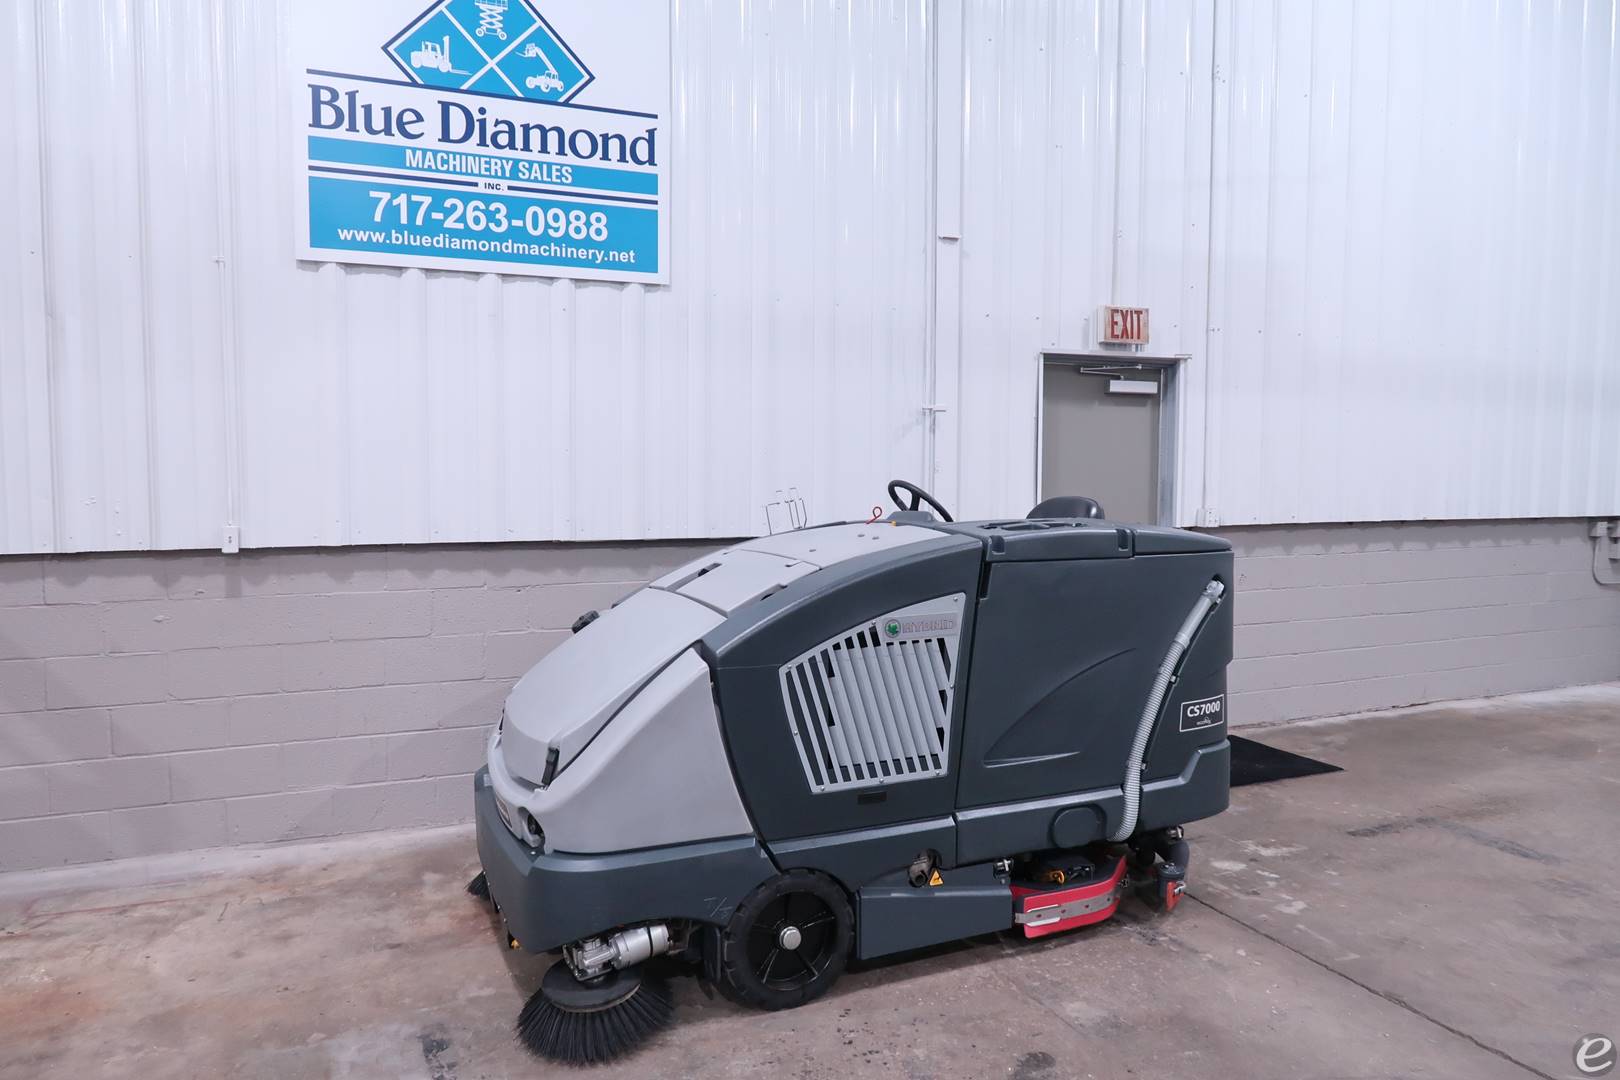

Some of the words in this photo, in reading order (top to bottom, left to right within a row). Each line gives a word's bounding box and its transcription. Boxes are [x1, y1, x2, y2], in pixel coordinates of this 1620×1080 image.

[307, 83, 425, 140] Blue
[437, 100, 658, 167] Diamond
[405, 149, 513, 178] MACHINERY
[518, 162, 573, 184] SALES
[483, 181, 504, 192] INC.
[369, 190, 609, 242] 717-263-0988
[338, 227, 636, 264] www.bluediamondmachinery.net
[1110, 308, 1143, 340] EXIT
[1187, 700, 1221, 717] CS7000
